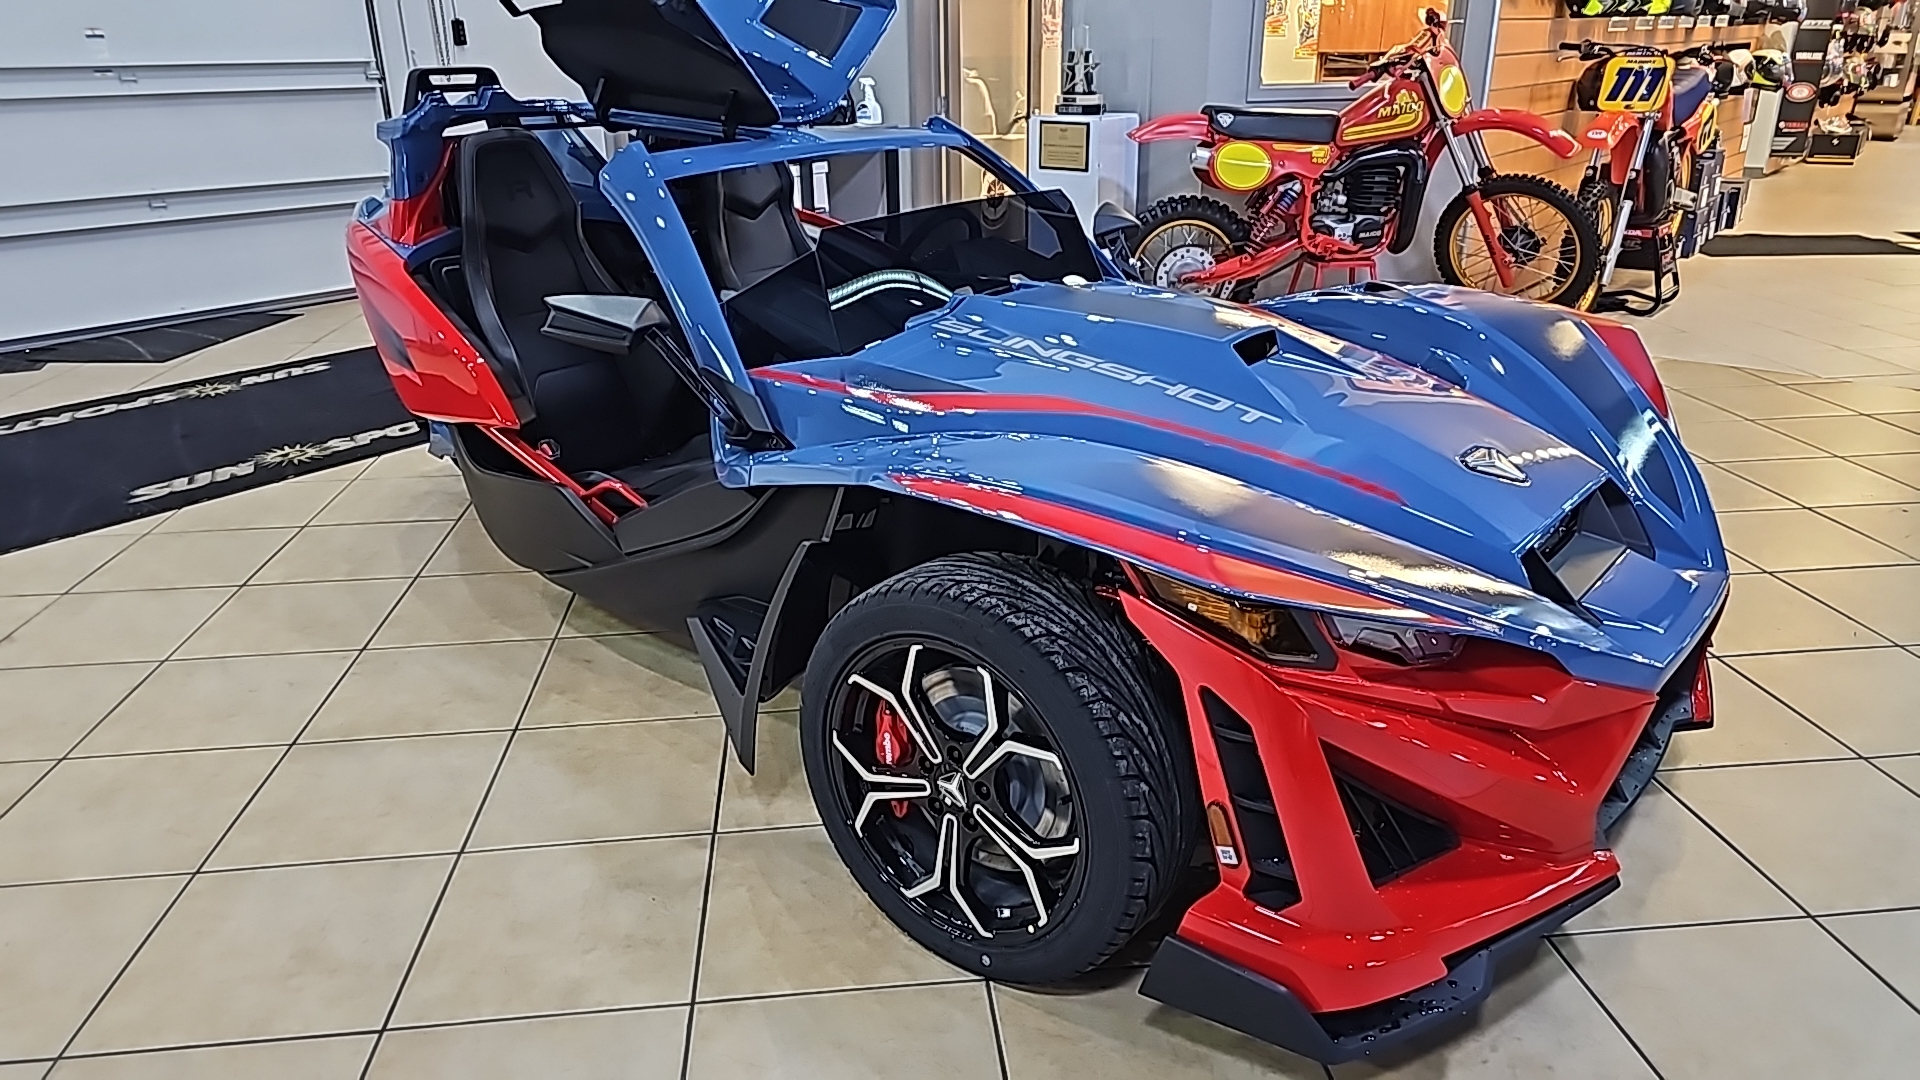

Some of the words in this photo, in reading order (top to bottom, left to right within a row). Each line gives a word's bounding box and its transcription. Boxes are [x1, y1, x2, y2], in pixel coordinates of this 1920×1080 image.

[1604, 66, 1666, 102] 111
[240, 361, 331, 386] SUN
[931, 316, 1284, 424] SLINGSHOT
[127, 460, 255, 504] SUN
